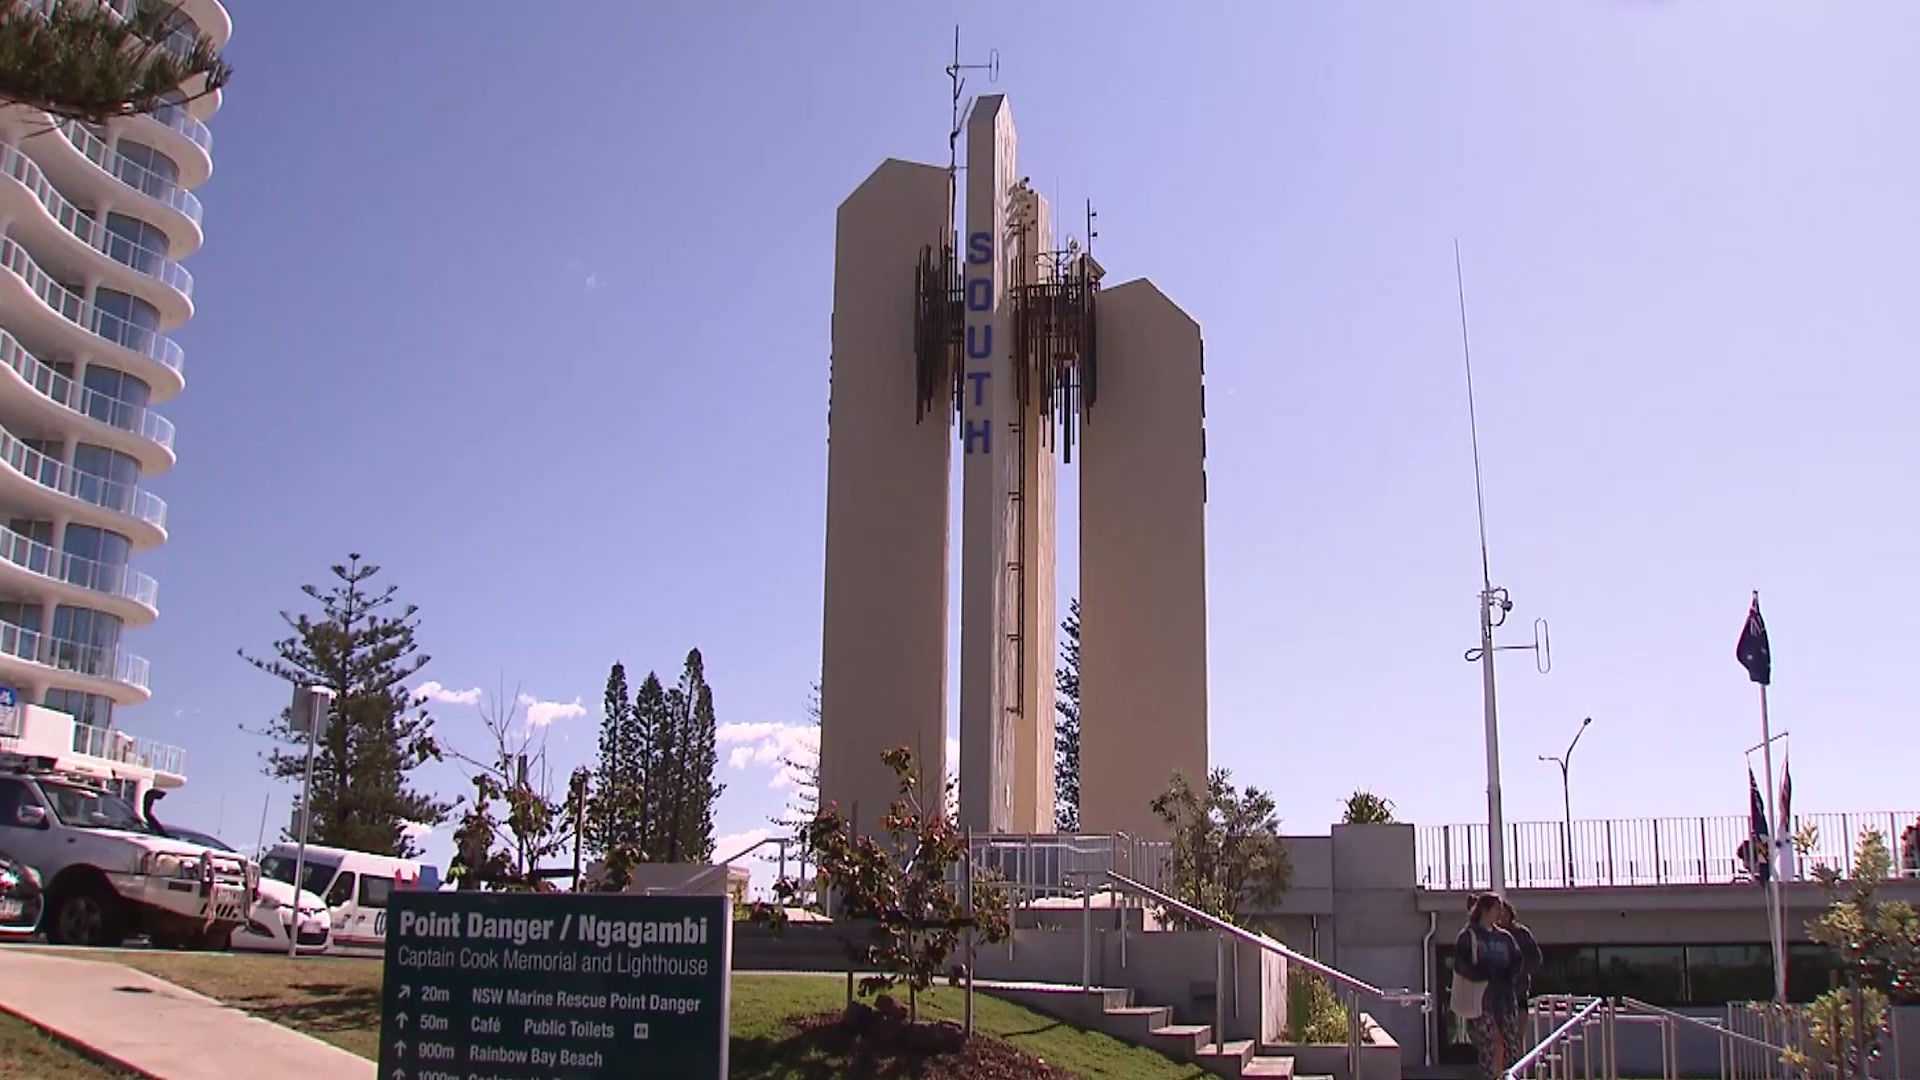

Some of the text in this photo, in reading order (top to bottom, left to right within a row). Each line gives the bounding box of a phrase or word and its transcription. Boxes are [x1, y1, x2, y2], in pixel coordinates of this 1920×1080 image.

[966, 231, 992, 454] SOUTH
[400, 911, 707, 948] Point Danger / Ngagambi
[398, 944, 708, 978] Captain Cook Memorial and Lighthouse
[421, 986, 701, 1014] 20m NSW Marine Rescue Point Danger
[420, 1014, 615, 1039] 50m Café Public Toilets
[418, 1042, 603, 1068] 900m Rainbow Bay Beach
